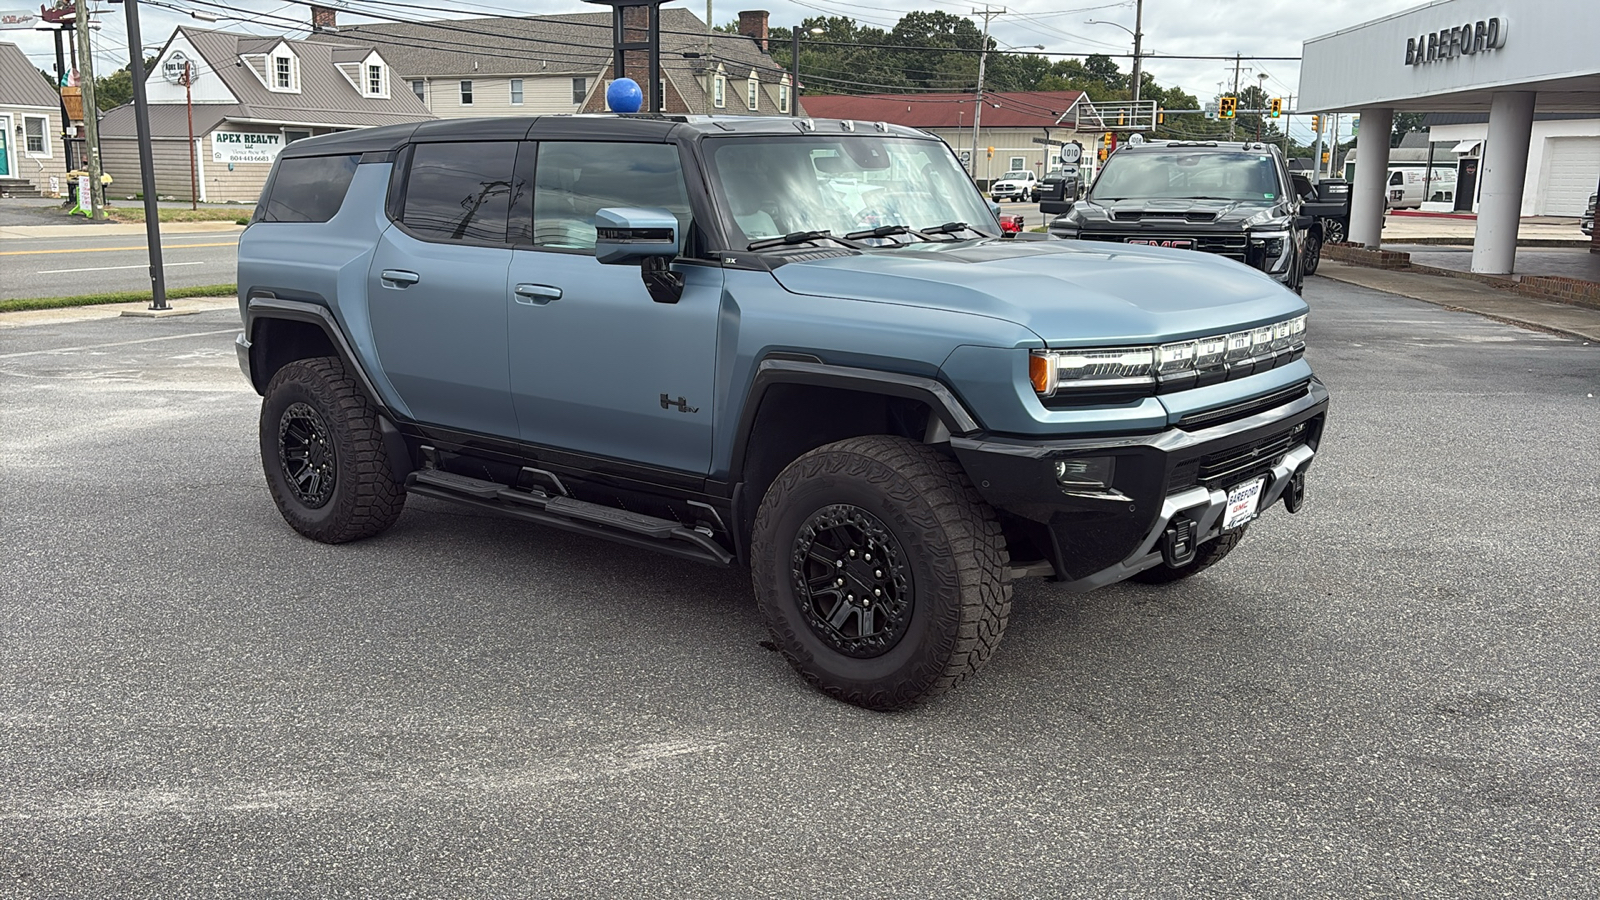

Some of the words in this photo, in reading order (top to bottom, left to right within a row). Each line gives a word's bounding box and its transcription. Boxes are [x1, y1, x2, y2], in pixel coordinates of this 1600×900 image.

[1404, 17, 1506, 67] BAREFORD
[216, 133, 242, 143] APEX
[243, 134, 280, 144] REALTY
[1063, 148, 1079, 157] 1010
[1173, 322, 1301, 360] HUMMER
[1229, 485, 1259, 506] BAREFORD
[1232, 500, 1250, 513] GMC
